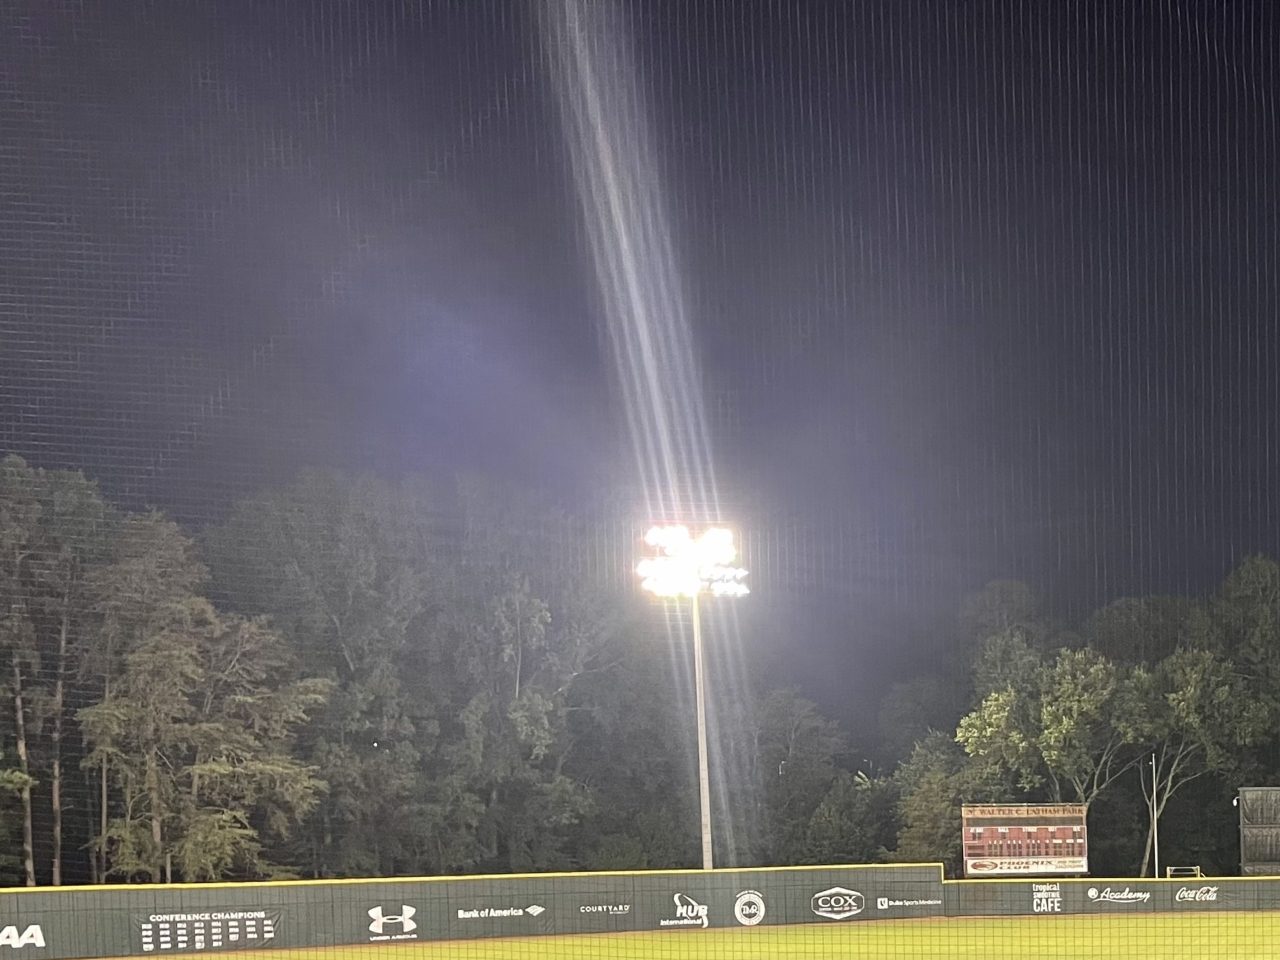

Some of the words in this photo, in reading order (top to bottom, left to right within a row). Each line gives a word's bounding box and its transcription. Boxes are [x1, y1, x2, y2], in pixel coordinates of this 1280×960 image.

[980, 807, 1014, 816] WALTER
[1026, 807, 1061, 816] LATHAM
[1062, 807, 1084, 816] PARK
[1032, 882, 1060, 893] tropical
[1099, 887, 1151, 903] Academy
[818, 895, 858, 908] COX
[903, 899, 919, 907] Sports
[1033, 898, 1062, 912] CAFE
[458, 909, 479, 919] Bank
[480, 908, 489, 918] of
[489, 907, 524, 918] America
[580, 904, 631, 913] COURTYARD
[676, 904, 708, 917] HUB
[149, 912, 210, 922] CONFERENCE
[211, 911, 266, 920] CHAMPIONS
[660, 918, 703, 926] International
